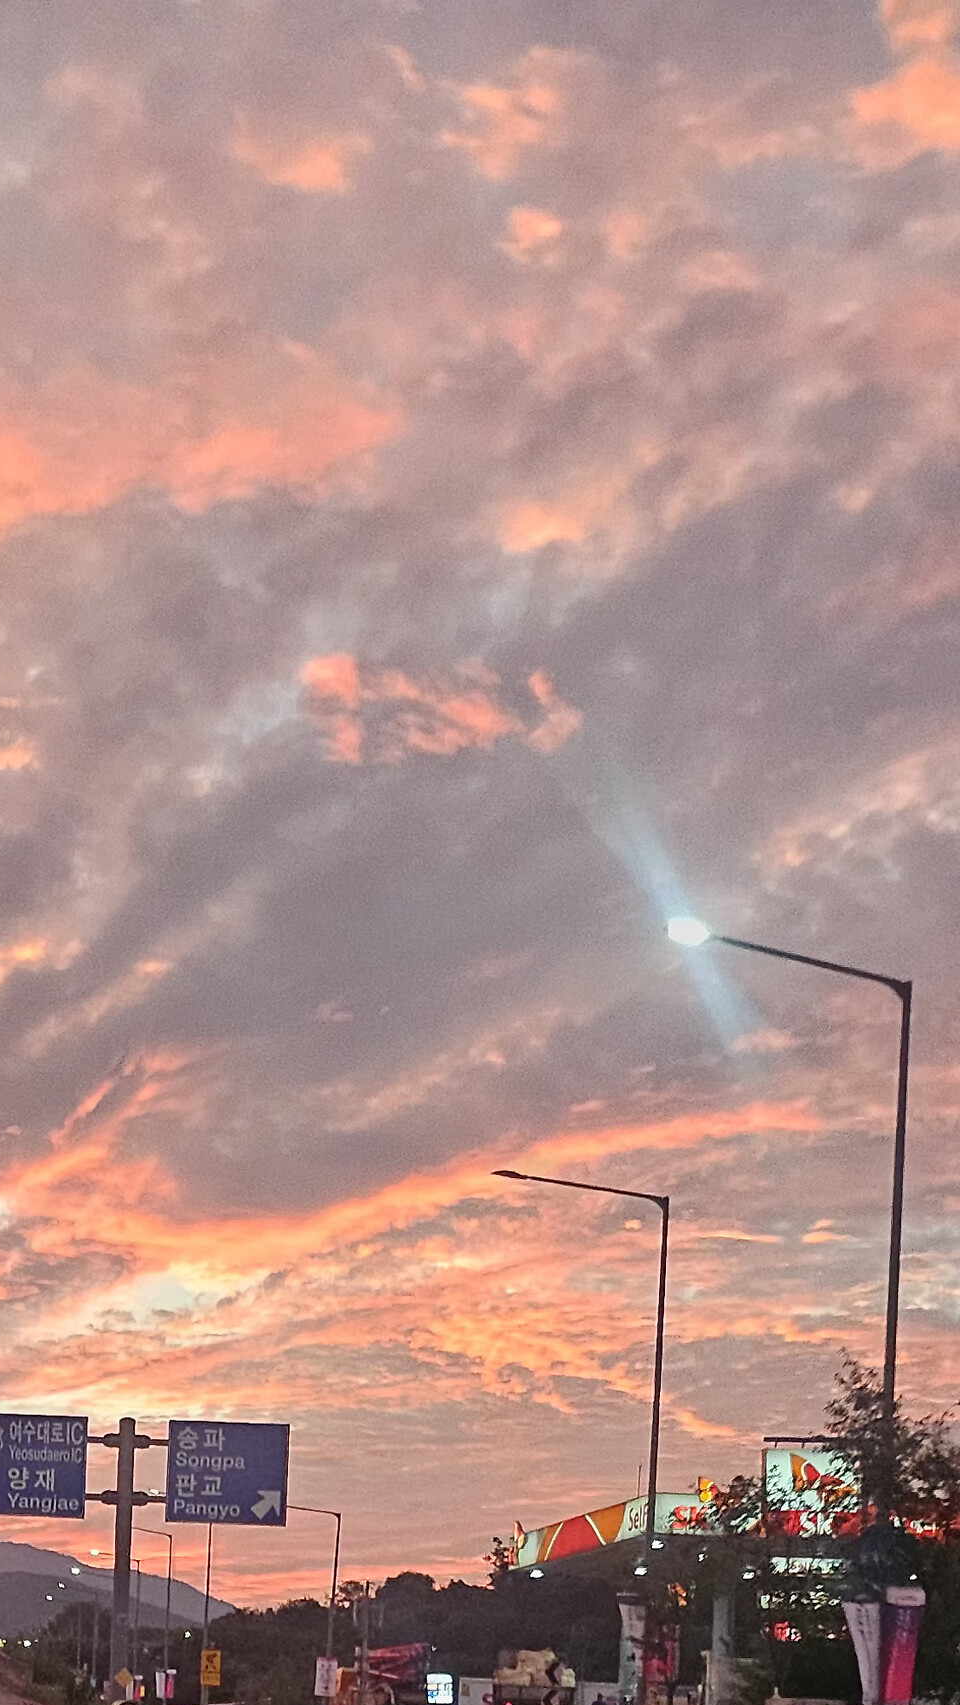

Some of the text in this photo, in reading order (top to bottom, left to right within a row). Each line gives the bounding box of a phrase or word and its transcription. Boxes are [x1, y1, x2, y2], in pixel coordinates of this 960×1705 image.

[177, 1426, 226, 1451] 송파
[175, 1450, 245, 1472] Songpa
[175, 1473, 222, 1497] 판교
[7, 1492, 79, 1513] Yangjae
[173, 1499, 240, 1520] Pangyo
[799, 1511, 836, 1538] SK
